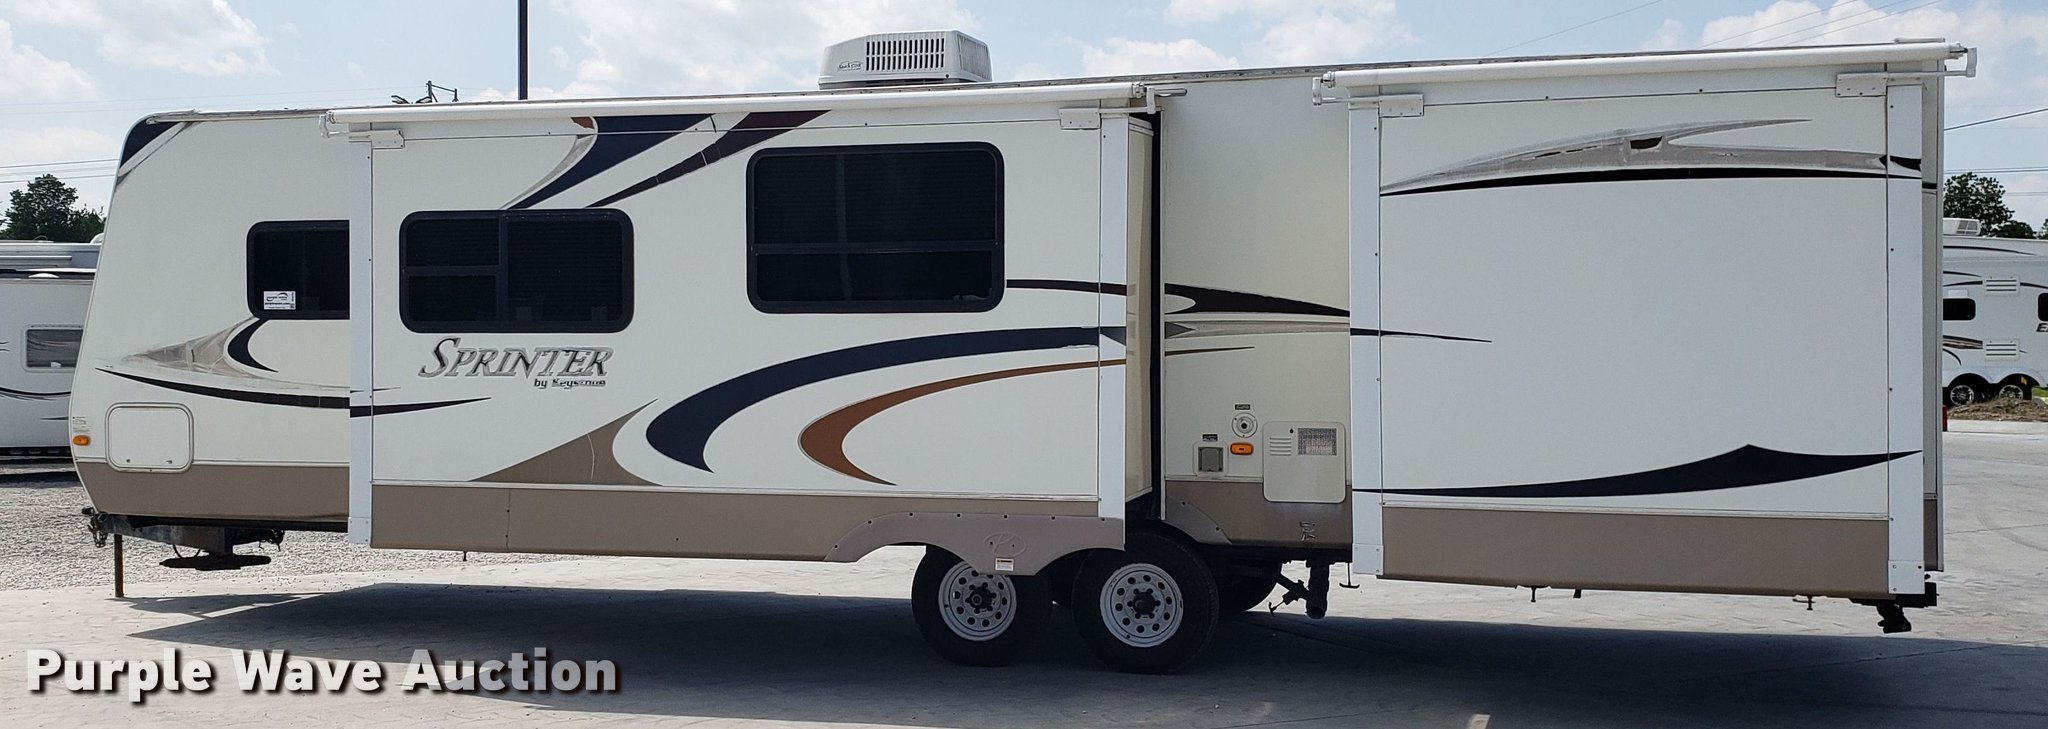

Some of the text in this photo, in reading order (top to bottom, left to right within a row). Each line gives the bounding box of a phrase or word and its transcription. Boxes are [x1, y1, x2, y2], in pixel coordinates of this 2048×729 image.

[418, 337, 614, 378] SPRINTER
[534, 378, 606, 389] by Keysone
